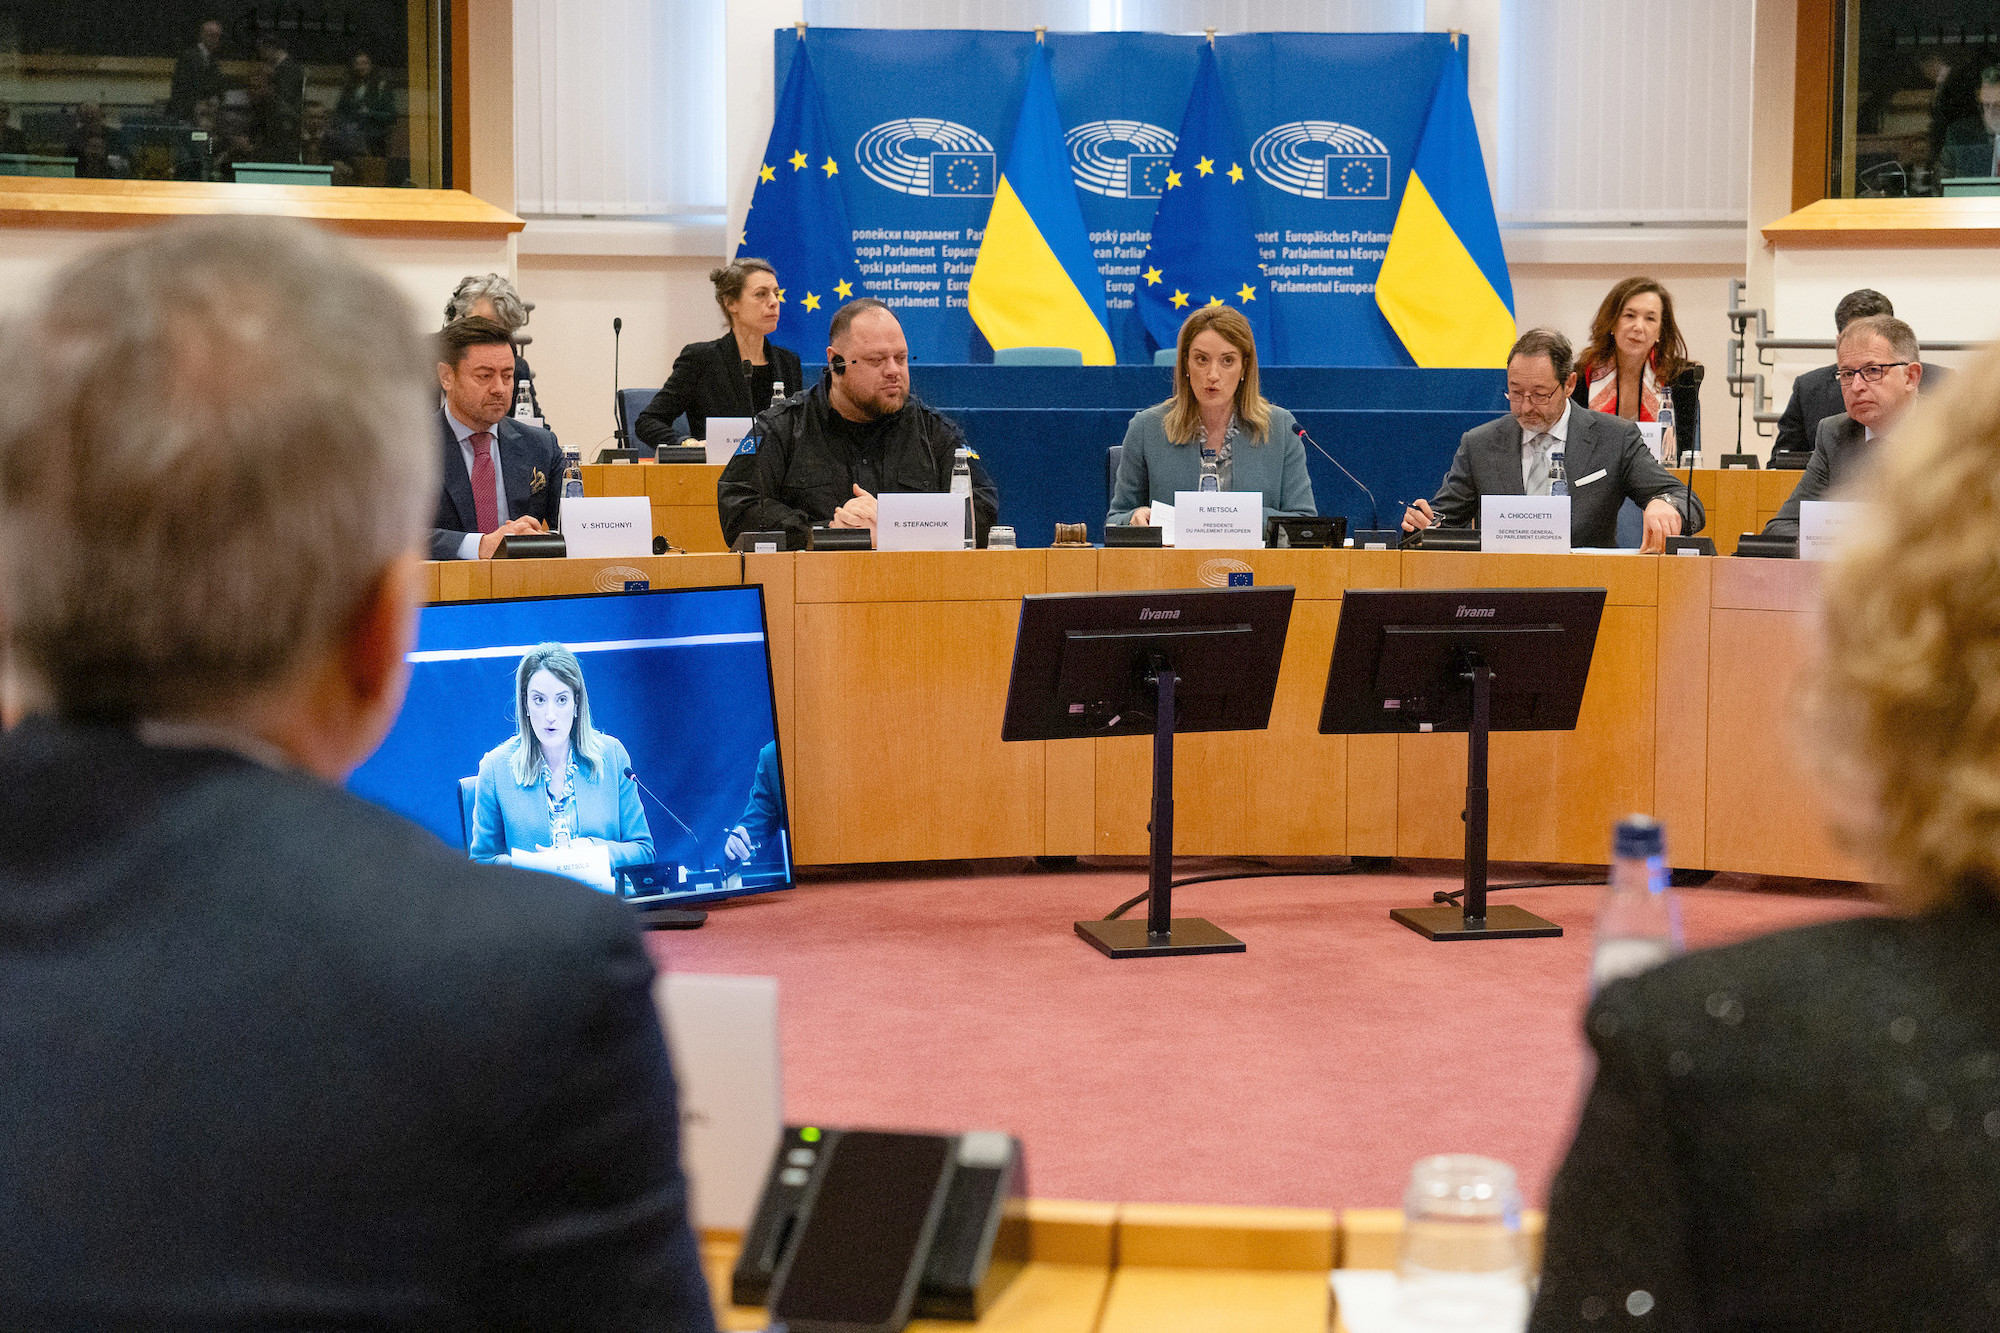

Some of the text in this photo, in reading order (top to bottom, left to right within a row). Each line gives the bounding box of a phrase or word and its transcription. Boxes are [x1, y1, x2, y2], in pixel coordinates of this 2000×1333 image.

[1285, 230, 1351, 245] Europäisches
[883, 244, 936, 257] Parlament
[1282, 247, 1335, 260] Parlaimint
[1335, 249, 1349, 260] na
[885, 261, 937, 276] parlament
[1302, 263, 1354, 276] Parlament
[894, 278, 941, 293] Ewropew
[1270, 280, 1333, 293] Parlamentul
[887, 295, 940, 309] parlament
[581, 521, 632, 530] V. SHTUCHNYI
[1139, 607, 1181, 621] iiyama
[1456, 604, 1496, 618] iiyama
